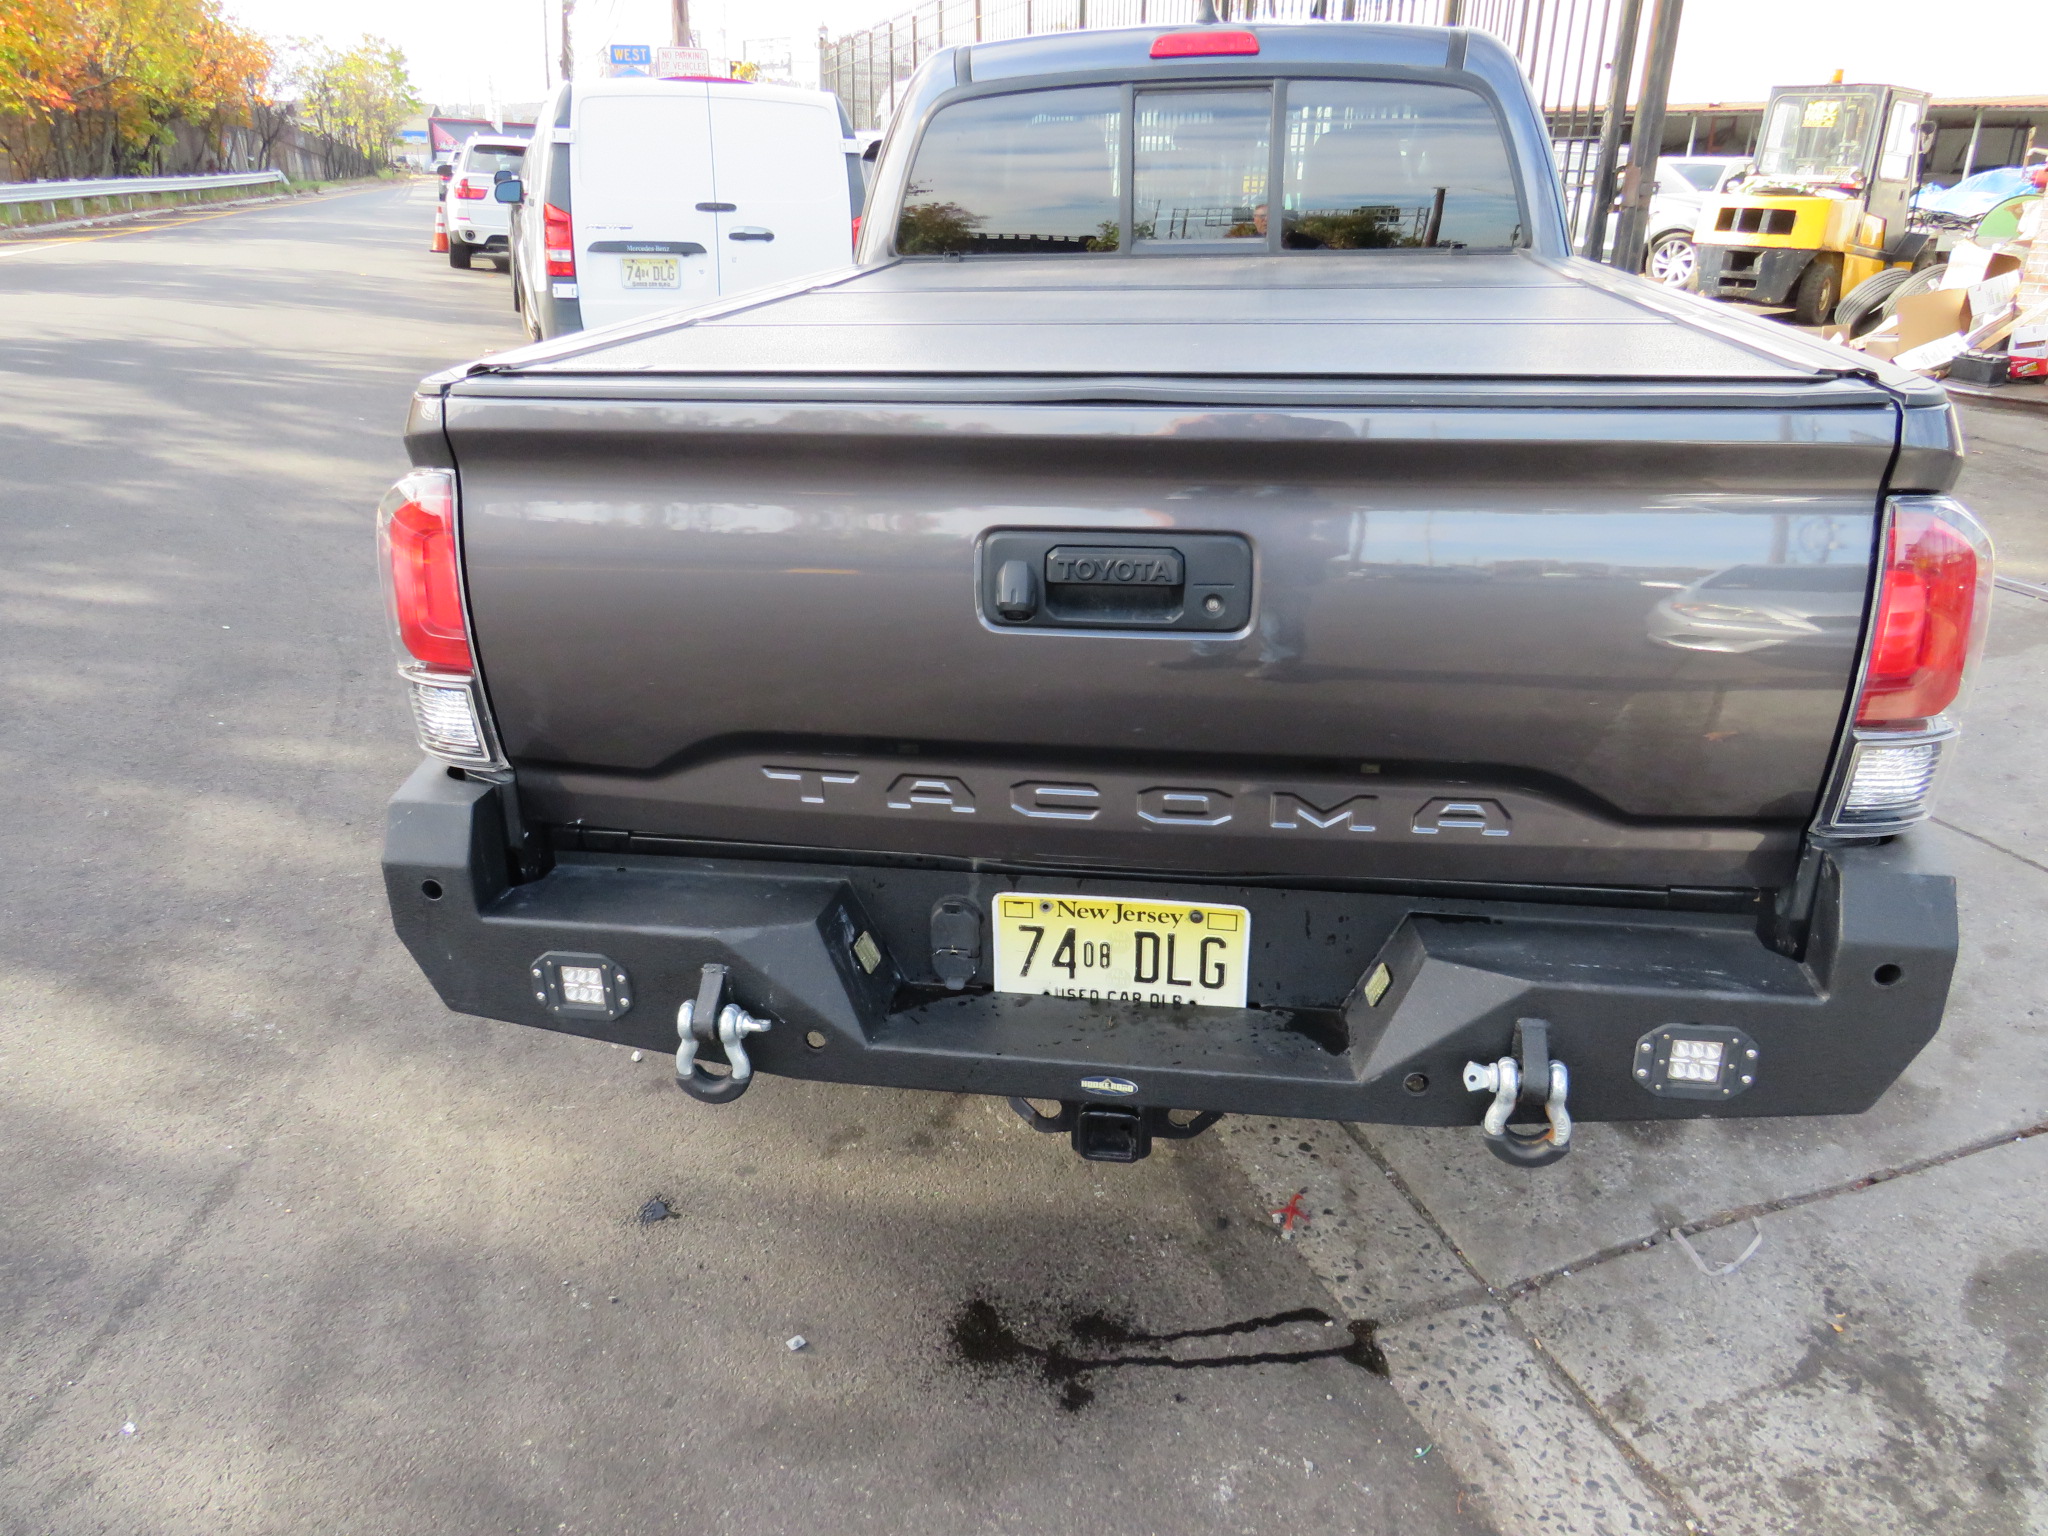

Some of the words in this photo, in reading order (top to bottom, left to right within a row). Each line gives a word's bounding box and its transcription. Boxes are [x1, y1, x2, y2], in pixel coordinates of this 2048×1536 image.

[614, 48, 647, 61] WEST
[661, 51, 671, 60] NO
[675, 51, 704, 60] PARKING
[661, 61, 670, 70] OF
[673, 61, 707, 71] VEHICLES
[653, 265, 675, 281] DLG
[1057, 558, 1172, 582] TOYOTA
[762, 765, 1512, 836] TACOMA
[1057, 900, 1109, 919] New
[1113, 903, 1184, 928] Jersey
[1133, 930, 1228, 989] DLG
